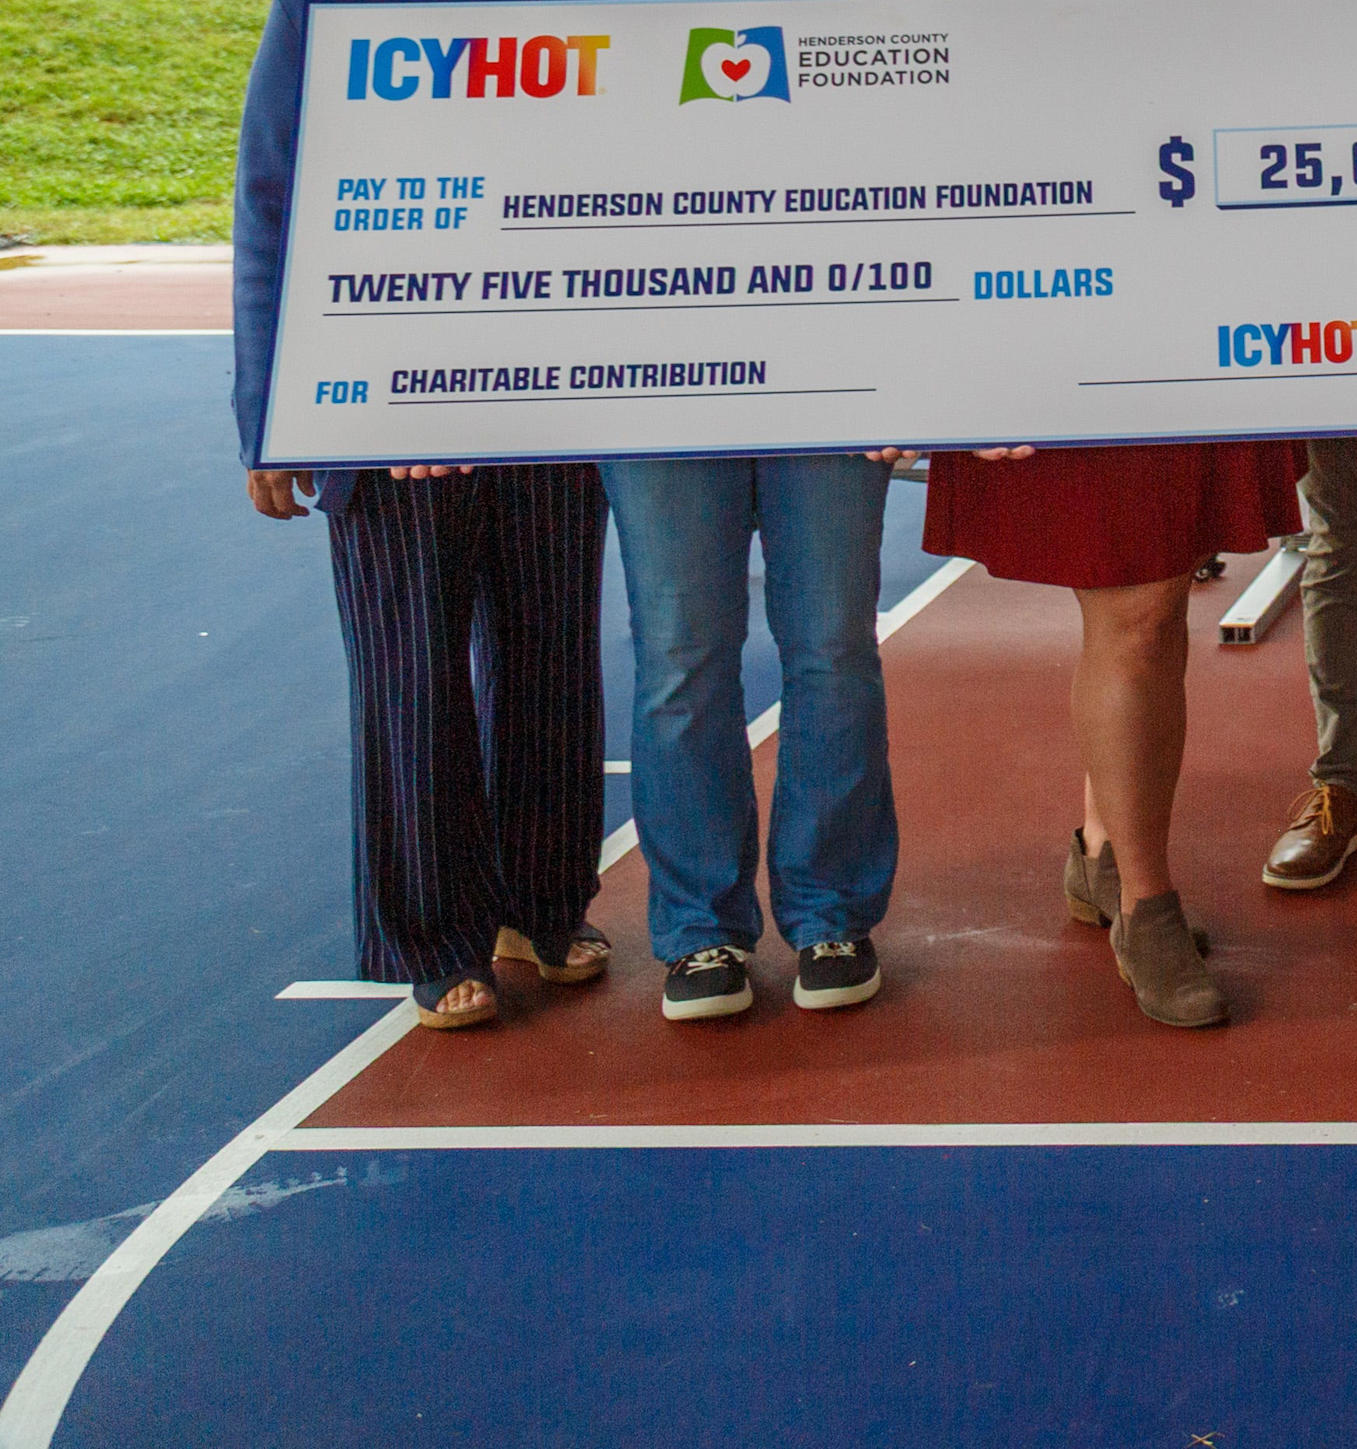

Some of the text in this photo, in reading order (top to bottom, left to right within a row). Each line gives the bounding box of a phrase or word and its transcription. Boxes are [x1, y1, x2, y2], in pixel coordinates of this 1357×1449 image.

[798, 33, 949, 46] HENDERSON COUNTY
[347, 35, 611, 102] ICYHOT
[798, 48, 949, 67] EDUCATION
[798, 70, 949, 87] FOUNDATION
[1158, 135, 1195, 208] $
[337, 176, 485, 202] PAY TO THE
[503, 181, 1093, 219] HENDERSON COUNTY EDUCATION FOUNDATION
[334, 207, 468, 233] ORDER OF
[327, 261, 933, 304] TWENTY FIVE THOUSAND AND 0/100
[973, 267, 1114, 300] DOLLARS
[315, 361, 767, 405] FOR CHARITABLE CONTRIBUTION
